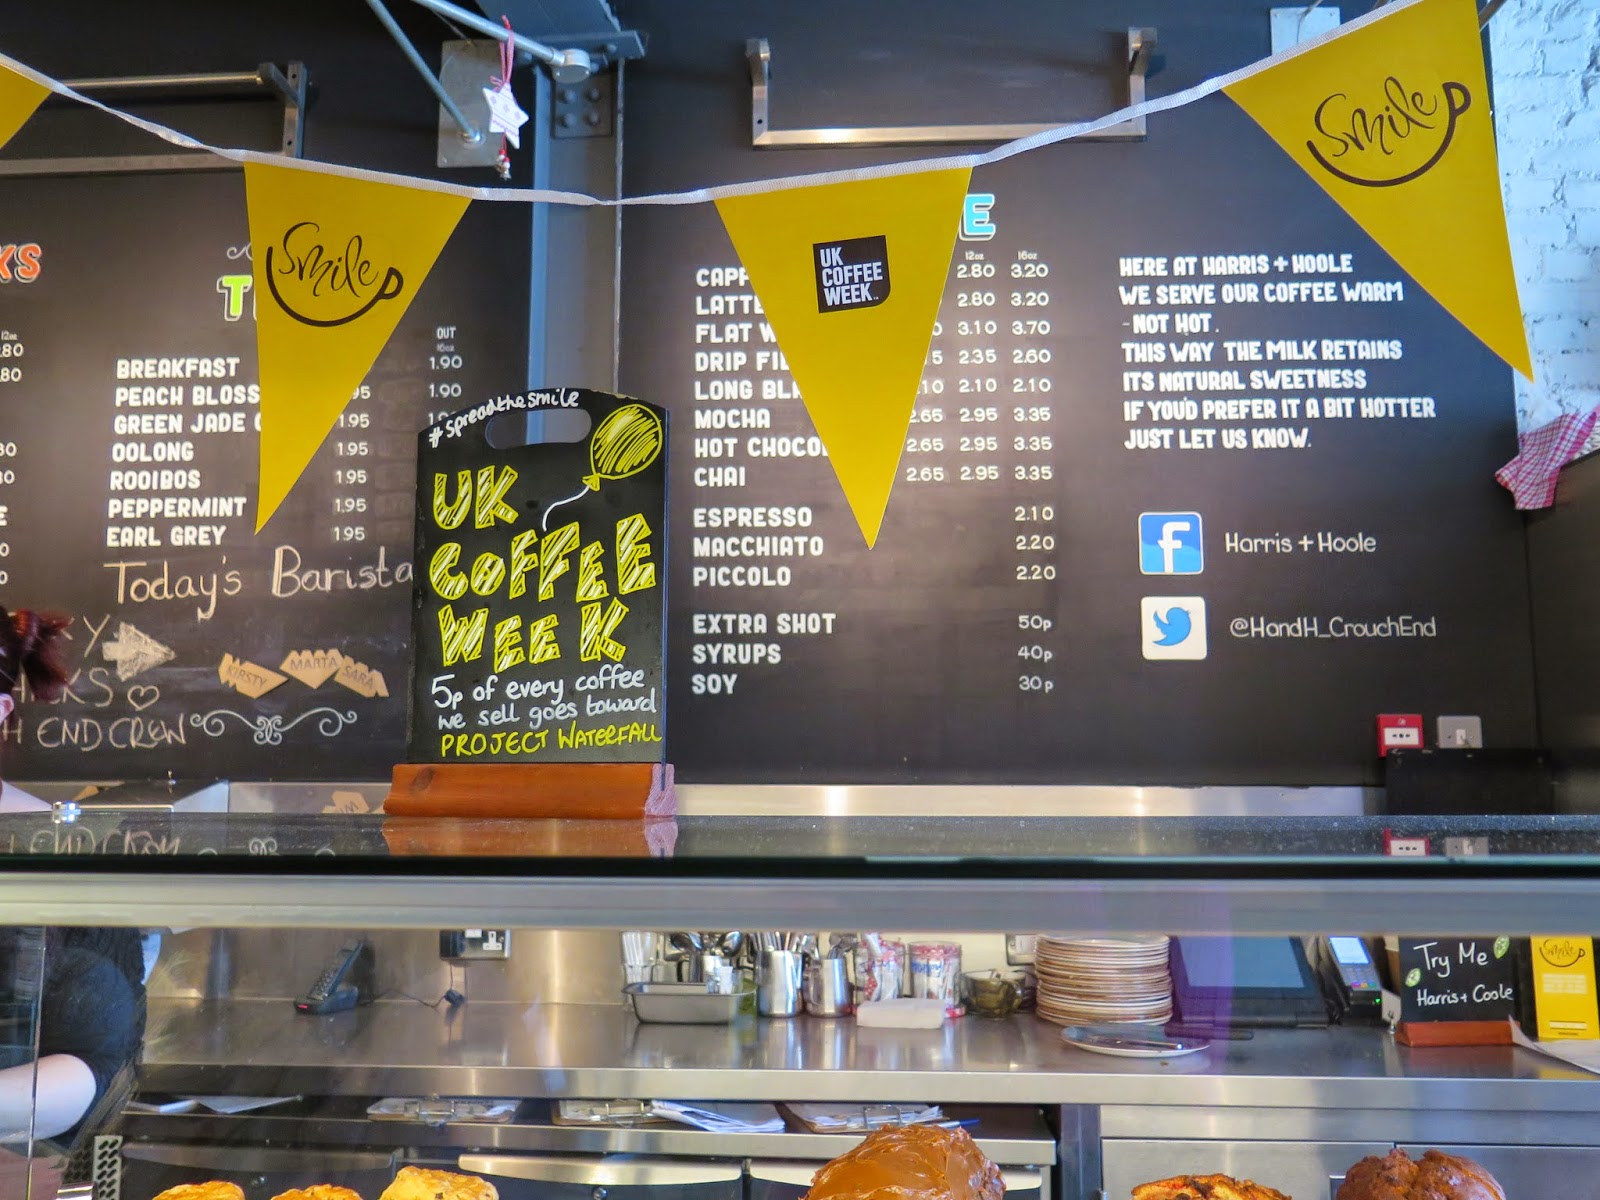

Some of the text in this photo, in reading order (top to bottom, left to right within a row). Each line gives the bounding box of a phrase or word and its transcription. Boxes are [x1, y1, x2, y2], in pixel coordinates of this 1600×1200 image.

[1314, 76, 1438, 157] Smile
[278, 222, 380, 298] Smile
[820, 247, 844, 267] UK
[1119, 257, 1168, 277] HERE
[1173, 256, 1198, 276] AT
[1202, 255, 1270, 276] HARRIS
[1292, 254, 1353, 274] HOOLE
[822, 261, 883, 287] COFFEE
[956, 264, 996, 278] 2.80
[1010, 263, 1049, 278] 3.20
[823, 283, 873, 306] WEEK
[956, 292, 996, 307] 2.80
[1010, 292, 1049, 306] 3.20
[1118, 281, 1404, 305] WE SERVE OUR COFFEE WARM
[437, 327, 456, 339] OUT
[696, 323, 752, 343] FLAT
[957, 320, 997, 335] 3.10
[1012, 320, 1051, 335] 3.70
[695, 351, 747, 372] DRIP
[756, 351, 790, 371] FIL
[958, 349, 998, 364] 2.35
[1012, 349, 1051, 364] 2.60
[1121, 339, 1403, 363] THIS WAY THE MILK RETAINS
[117, 355, 463, 379] BREAKFAST 1.90
[694, 380, 753, 400] LONG
[958, 378, 998, 393] 2.10
[1012, 378, 1052, 393] 2.10
[1123, 369, 1367, 392] ITS NATURAL SWEETNESS
[115, 385, 183, 407] PEACH
[193, 384, 261, 406] BLOSS
[428, 383, 462, 398] 1.90
[694, 407, 1051, 429] MOCHA 2.65 2.95 3.35
[1123, 401, 1144, 421] IF
[1202, 399, 1277, 420] PREFER
[1281, 399, 1301, 419] IT
[1305, 398, 1319, 419] A
[1324, 397, 1355, 418] BIT
[1361, 397, 1437, 418] HOTTER
[114, 413, 183, 435] GREEN
[191, 413, 246, 433] JADE
[694, 436, 1052, 458] HOT CHOCO 2.65 2.95 3.35
[1123, 428, 1174, 449] JUST
[1179, 428, 1216, 449] LET
[1221, 428, 1248, 449] US
[112, 442, 194, 462] OOLONG
[110, 470, 201, 490] ROOIBOS
[694, 466, 1053, 488] CHAI 2.65 2.95 3.35
[108, 497, 247, 519] PEPPERMINT
[433, 465, 518, 529] UK
[693, 506, 1054, 528] ESPRESSO 2.10
[107, 527, 161, 548] EARL
[170, 525, 227, 546] GREY
[693, 535, 1055, 557] MACCHIATO 2.20
[1225, 531, 1293, 553] Harris
[1317, 531, 1376, 553] Hoole
[429, 513, 656, 602] COFFEE
[103, 545, 413, 622] Today's Barista
[693, 565, 1056, 587] PICCOLO 2.20
[693, 613, 1052, 634] EXTRA SHOT 50p
[438, 597, 629, 674] WEEK
[692, 643, 1053, 664] SYRUPS 40p
[290, 657, 339, 671] MARTA
[342, 665, 375, 690] SARA
[692, 674, 737, 694] SOY
[431, 663, 645, 710] 5p of every coffee
[438, 687, 657, 731] we sell goes toward
[441, 720, 663, 758] PROJECT WATERFALL
[1413, 941, 1488, 978] Try Me
